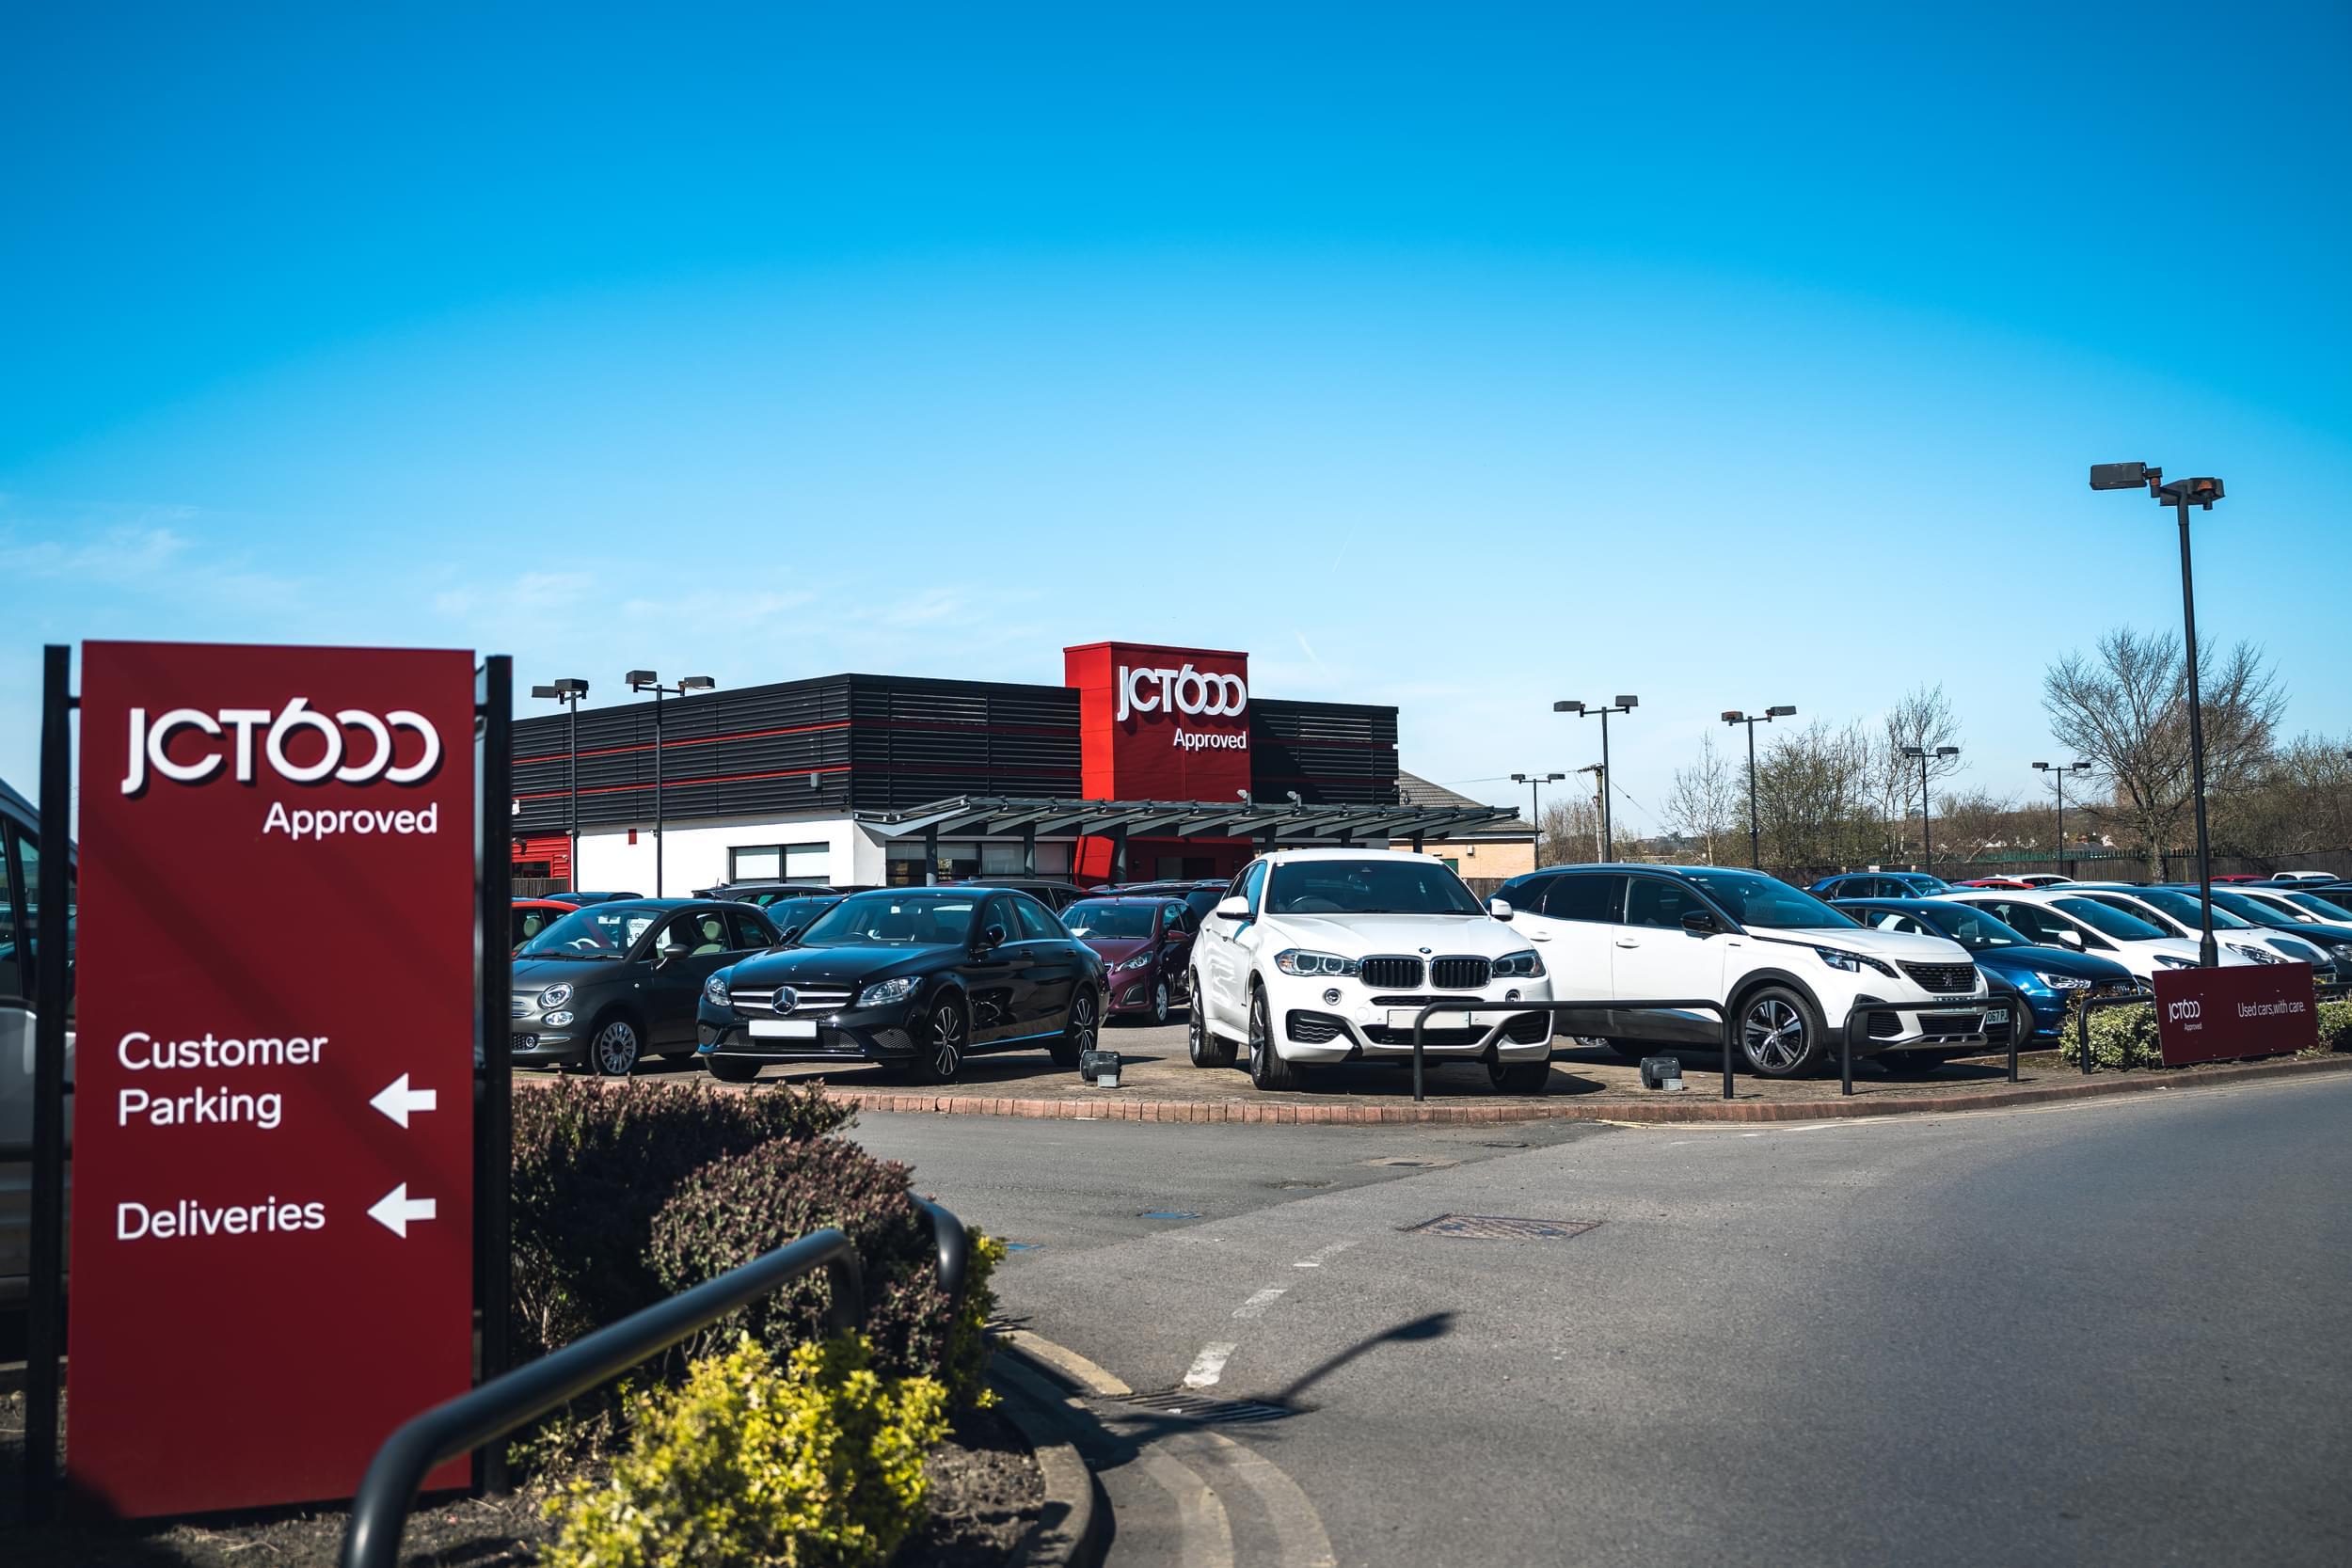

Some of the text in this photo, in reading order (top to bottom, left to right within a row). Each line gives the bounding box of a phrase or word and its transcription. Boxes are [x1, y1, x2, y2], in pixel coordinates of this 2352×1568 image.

[1117, 663, 1248, 721] JCT600
[121, 697, 440, 794] JCT600
[1173, 728, 1247, 752] Approved
[262, 802, 437, 840] Approved
[2168, 999, 2201, 1023] JCT600
[2184, 1022, 2202, 1032] Approved
[2237, 1002, 2257, 1017] Used
[119, 1032, 328, 1069] Customer
[119, 1087, 281, 1129] Parking
[118, 1196, 326, 1240] Deliveries
